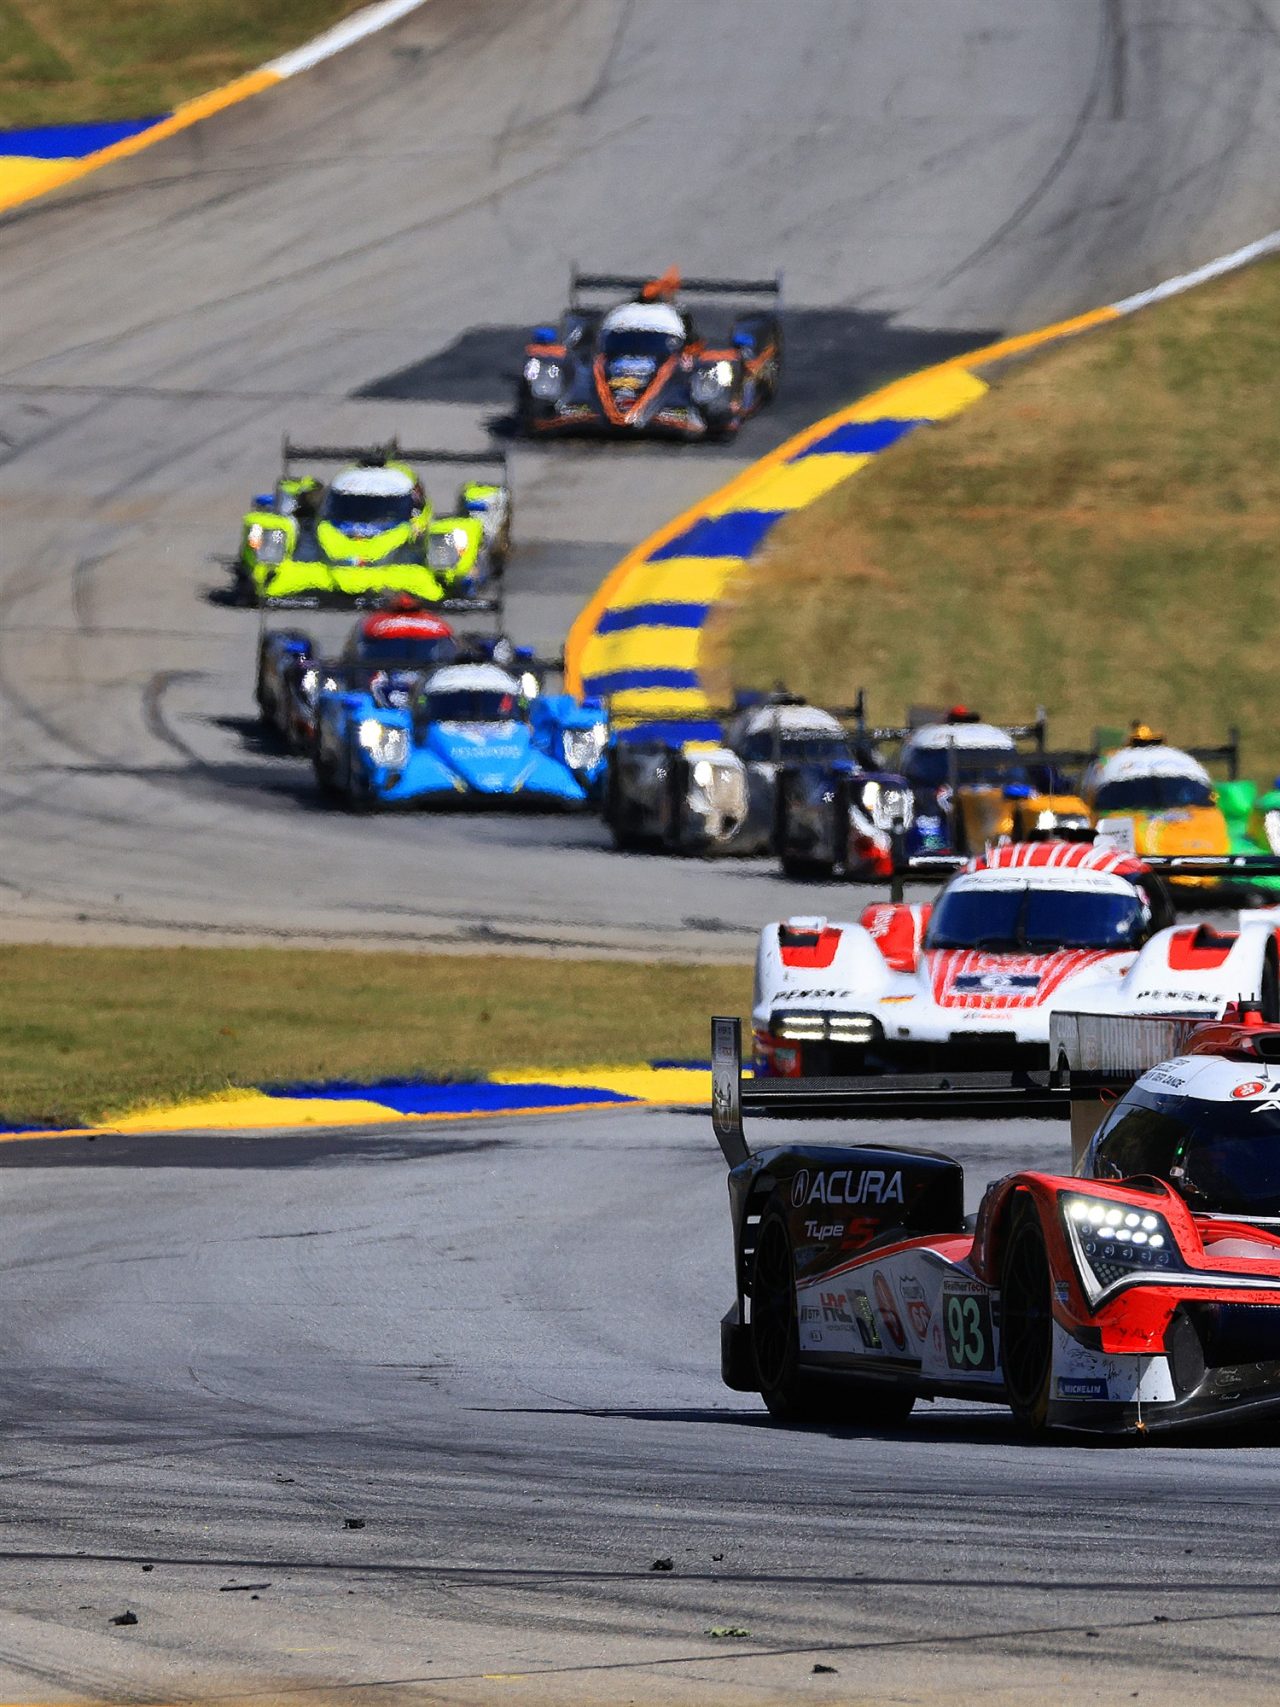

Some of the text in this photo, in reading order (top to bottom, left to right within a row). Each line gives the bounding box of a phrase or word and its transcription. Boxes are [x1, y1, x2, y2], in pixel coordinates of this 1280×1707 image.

[962, 877, 1113, 888] PORSCHE
[1136, 990, 1224, 1003] PENSKE
[806, 1170, 905, 1204] ACURA
[804, 1218, 880, 1249] Type S
[947, 1296, 985, 1366] 93
[1064, 1384, 1102, 1395] MICHELIN
